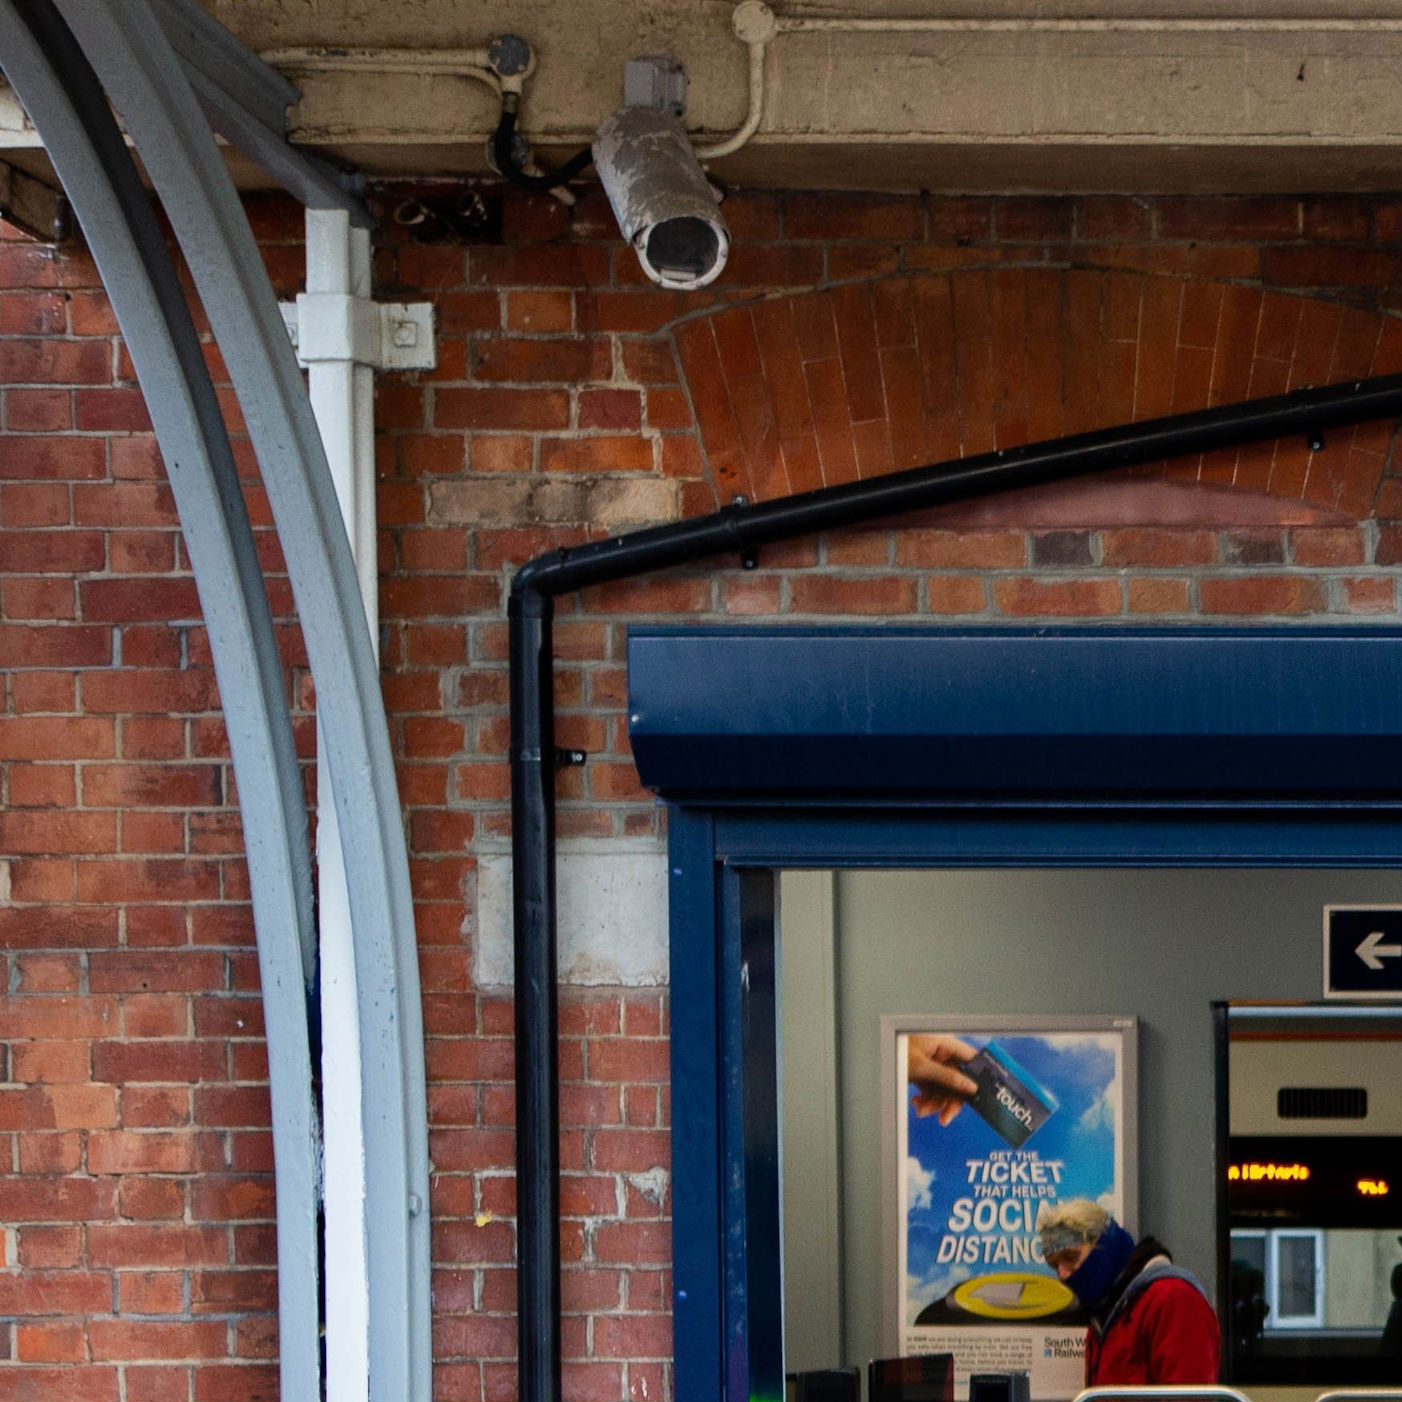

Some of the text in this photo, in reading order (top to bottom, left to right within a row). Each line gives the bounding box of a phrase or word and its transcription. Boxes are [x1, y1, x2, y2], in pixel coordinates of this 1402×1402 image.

[989, 1151, 1038, 1162] GET THE
[966, 1160, 1064, 1184] TICKET
[973, 1185, 1057, 1198] THAT HELPS
[1044, 1337, 1076, 1349] South
